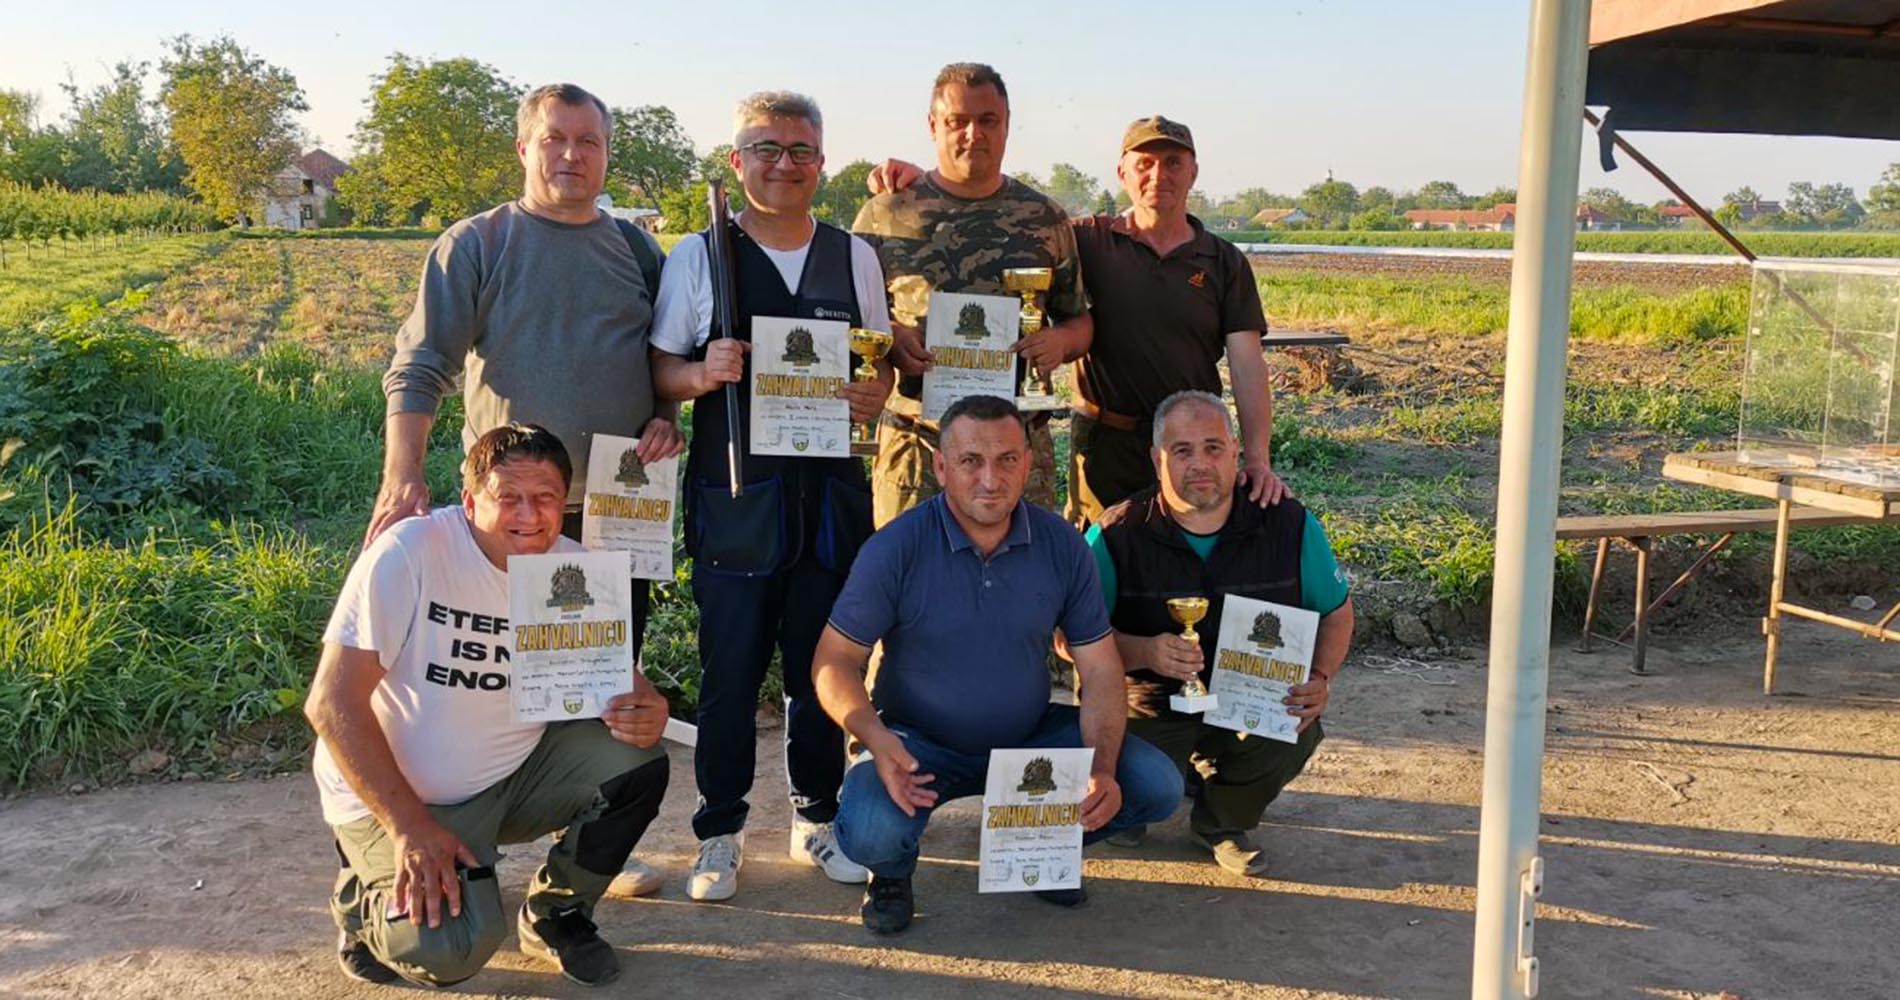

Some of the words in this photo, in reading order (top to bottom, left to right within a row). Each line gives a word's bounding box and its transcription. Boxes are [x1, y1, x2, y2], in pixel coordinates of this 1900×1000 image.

[755, 373, 846, 399] ZAHVALNICU
[588, 492, 672, 522] ZAHVALNICU
[451, 638, 487, 661] IS
[515, 620, 627, 652] ZAHVALNICU
[425, 662, 511, 691] ENO
[1218, 648, 1306, 686] ZAHVALNICU
[987, 803, 1080, 829] ZAHVALNICU
